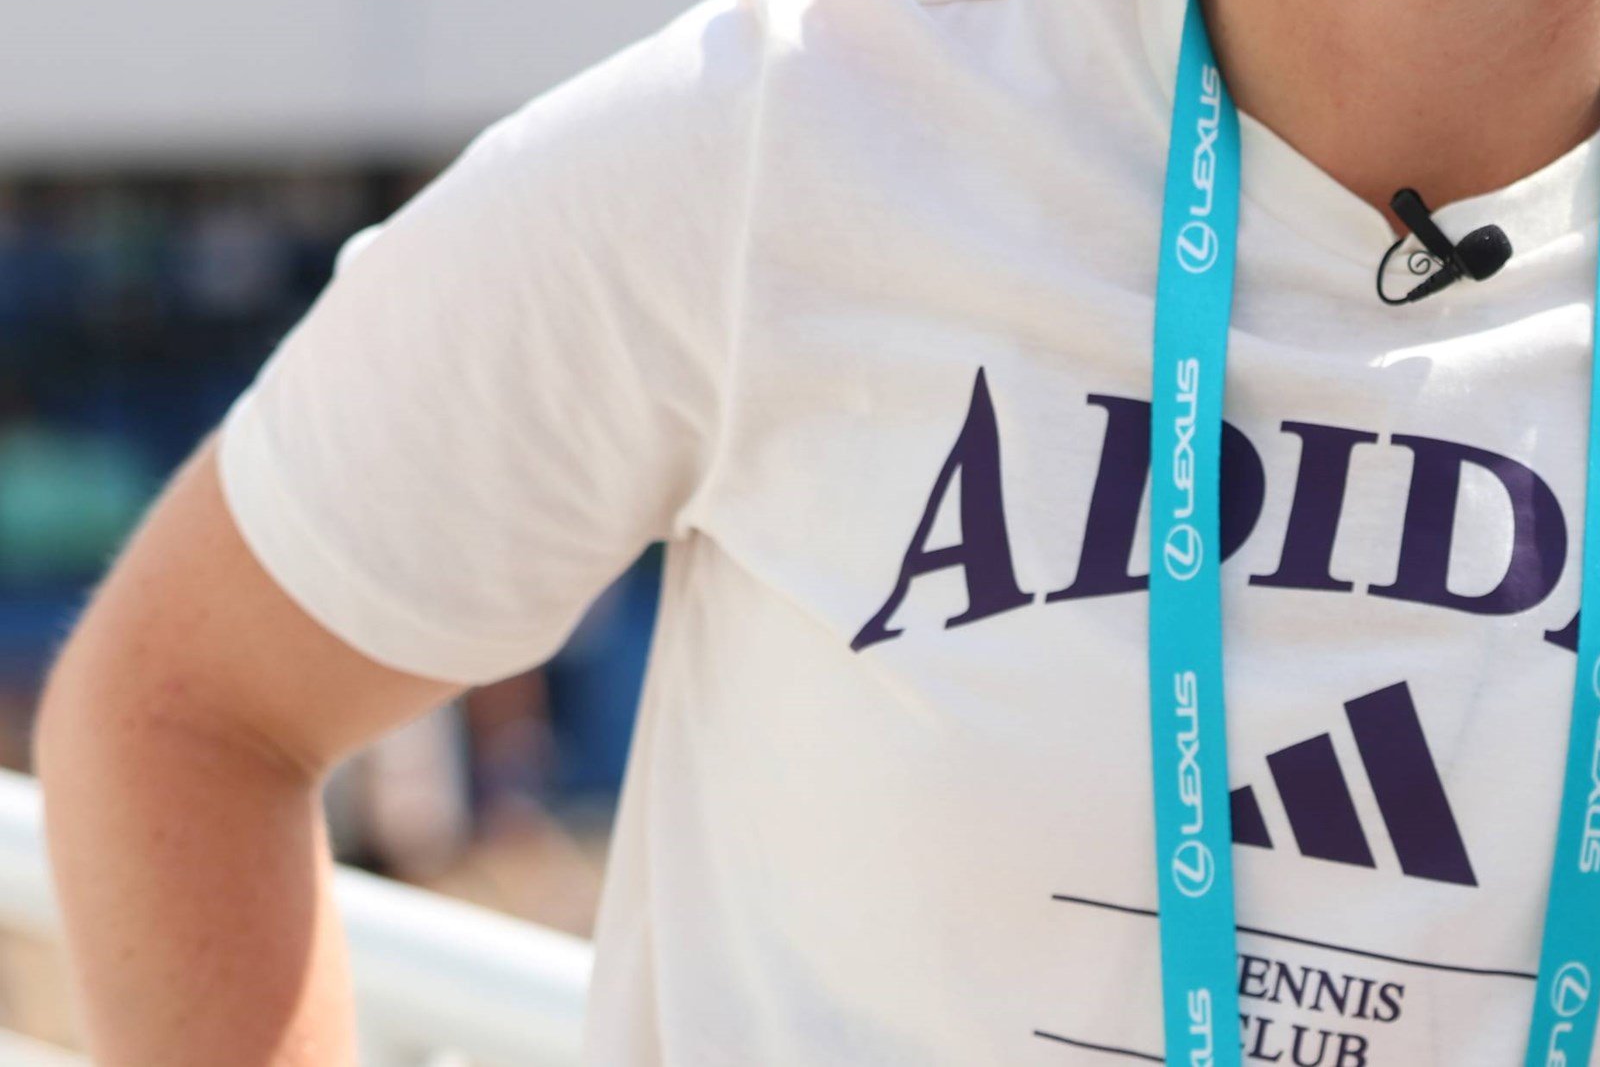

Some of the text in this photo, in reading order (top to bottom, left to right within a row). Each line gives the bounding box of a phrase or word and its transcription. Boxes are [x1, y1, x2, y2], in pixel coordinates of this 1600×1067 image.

[1190, 64, 1220, 217] LEXUS
[1173, 358, 1199, 518] LEXUS
[1174, 670, 1203, 835] LEXUS
[1236, 953, 1406, 1024] ENNIS
[1238, 1013, 1369, 1067] LUB
